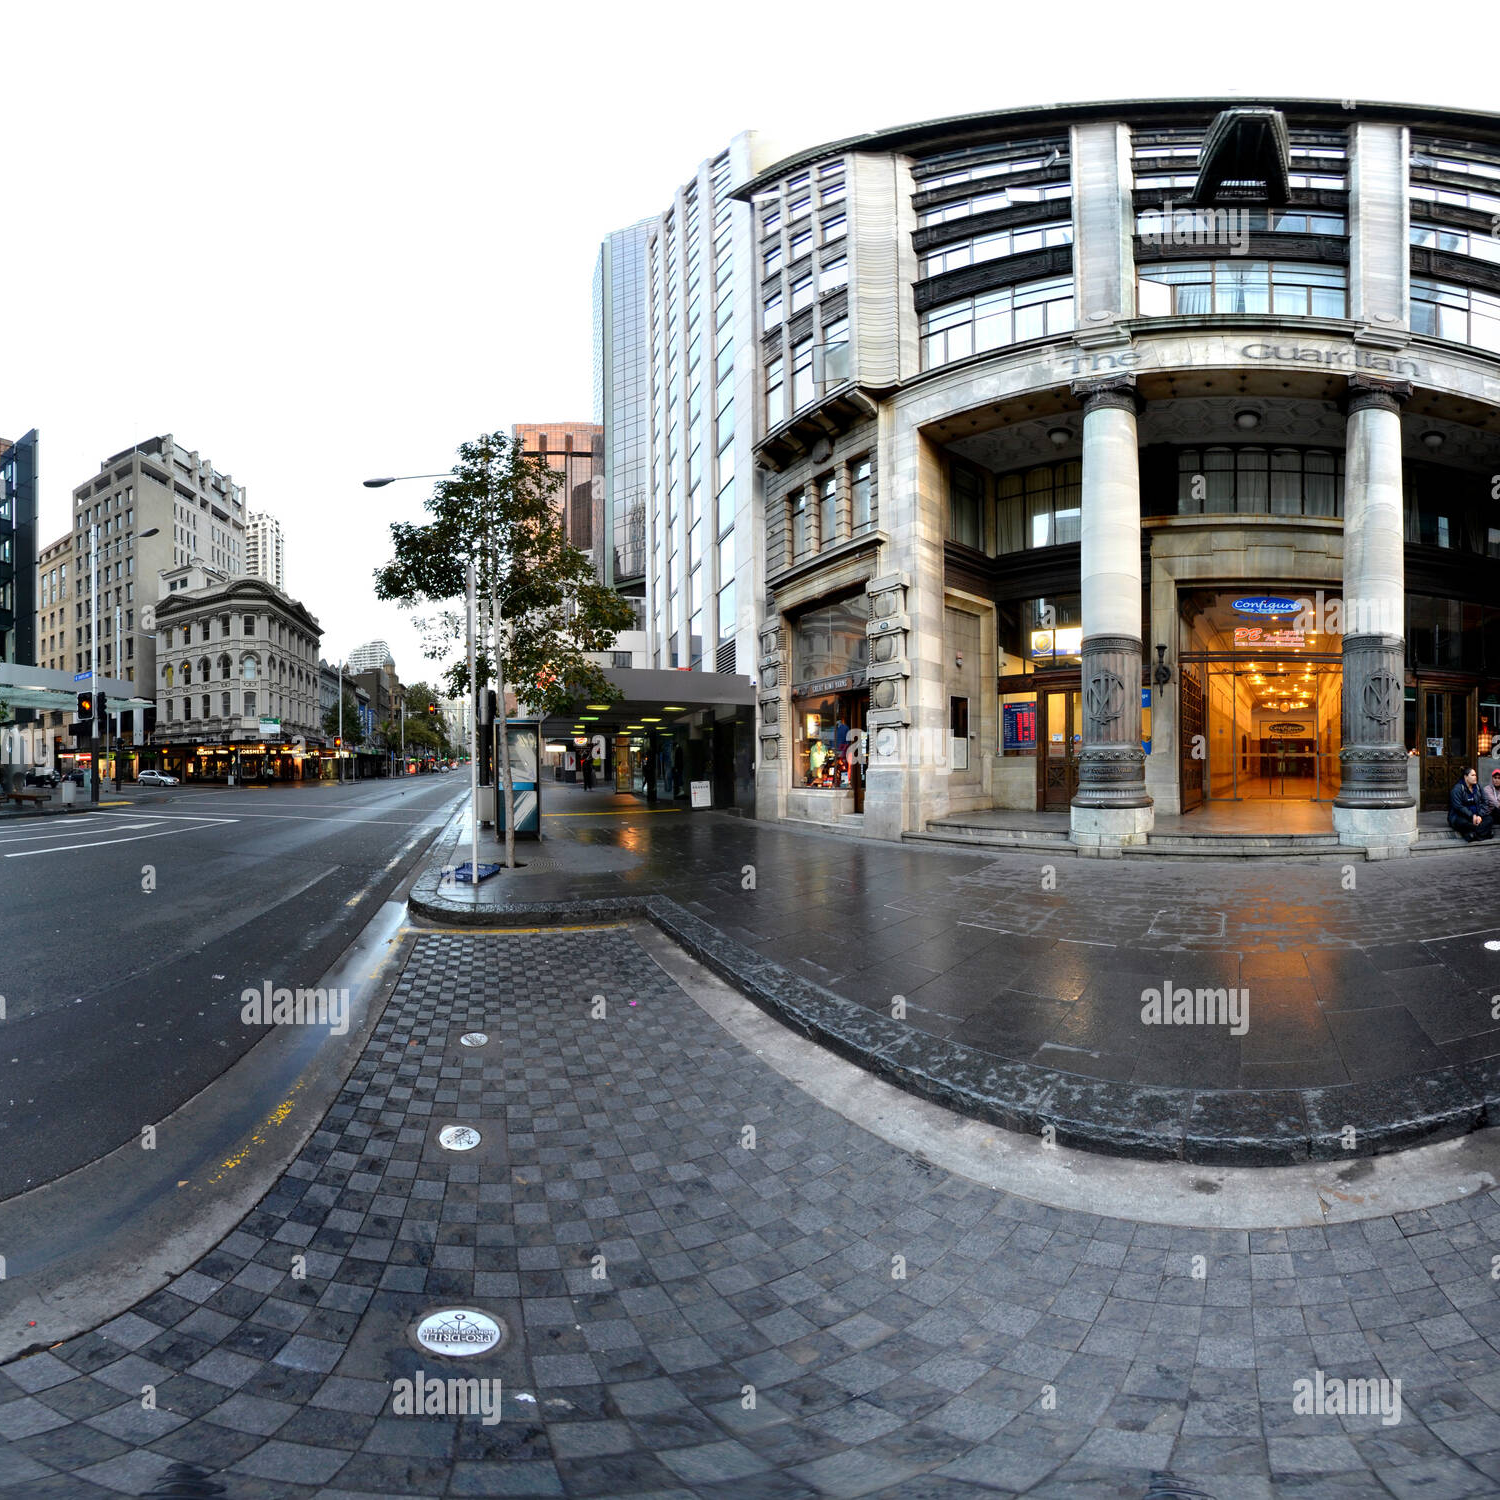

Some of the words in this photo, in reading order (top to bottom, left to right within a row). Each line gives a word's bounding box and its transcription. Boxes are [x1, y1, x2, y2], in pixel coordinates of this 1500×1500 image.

[1062, 352, 1142, 375] The
[1242, 343, 1420, 377] Guardian
[422, 1332, 492, 1343] PRO-DRILL
